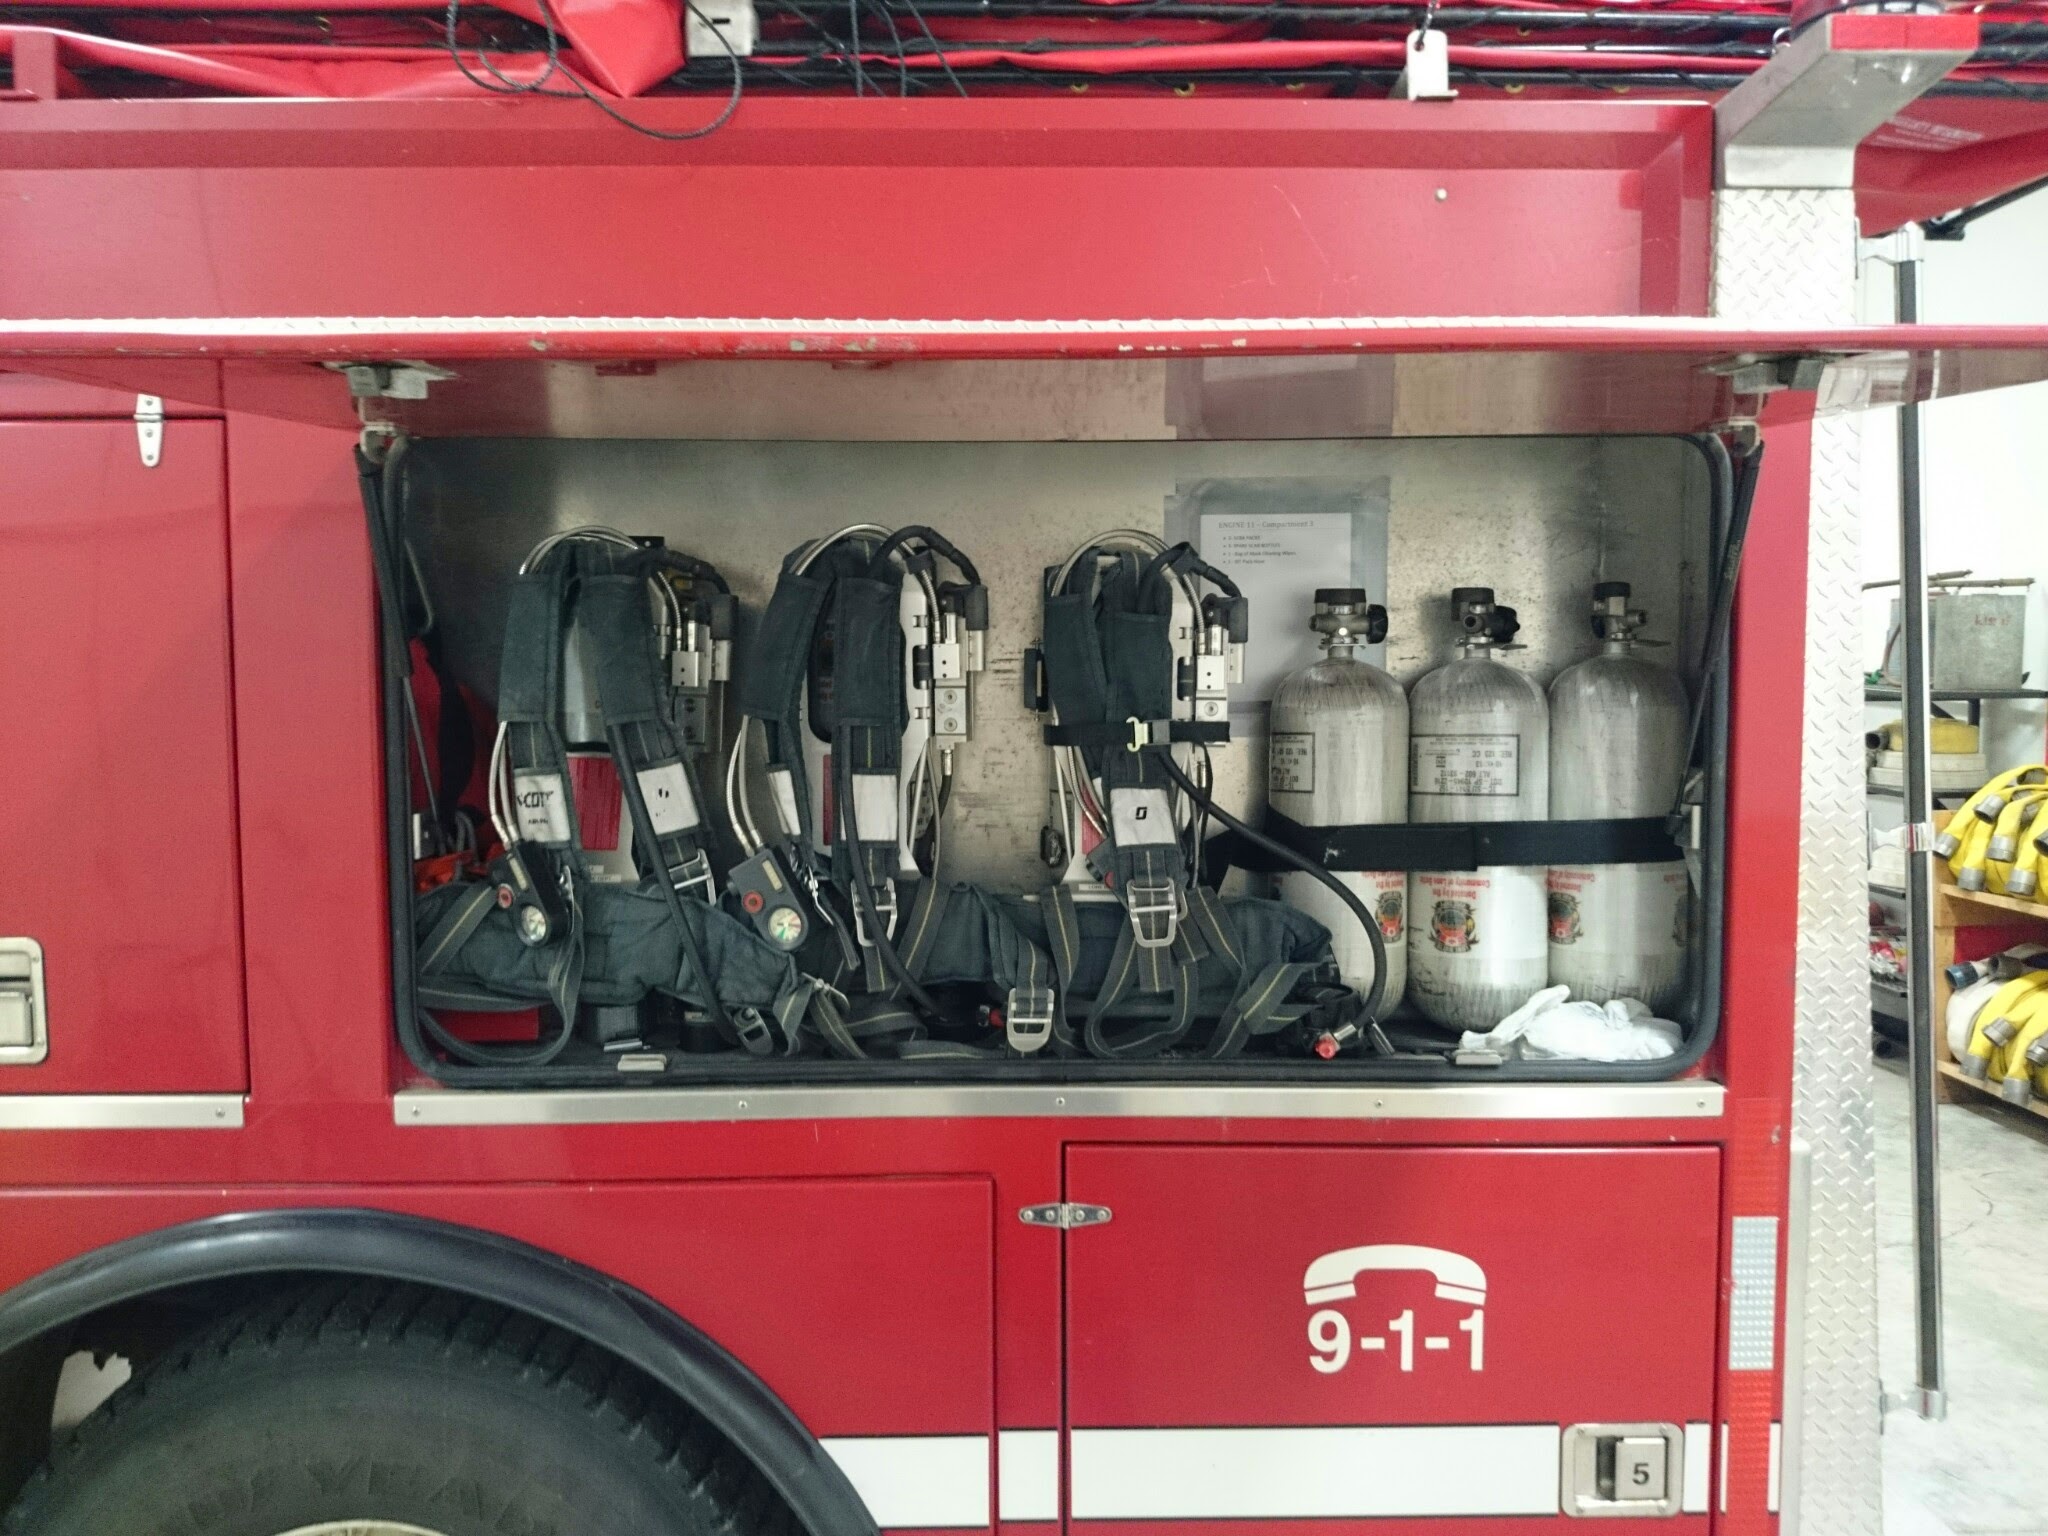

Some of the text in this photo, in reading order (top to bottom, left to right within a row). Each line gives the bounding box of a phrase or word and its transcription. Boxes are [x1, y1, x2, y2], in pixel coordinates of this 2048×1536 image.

[1218, 521, 1245, 529] ENGINE
[1262, 520, 1308, 530] Compartment
[1455, 876, 1491, 889] Community
[1307, 1309, 1484, 1374] 9-1-1
[1632, 1462, 1650, 1485] 5
